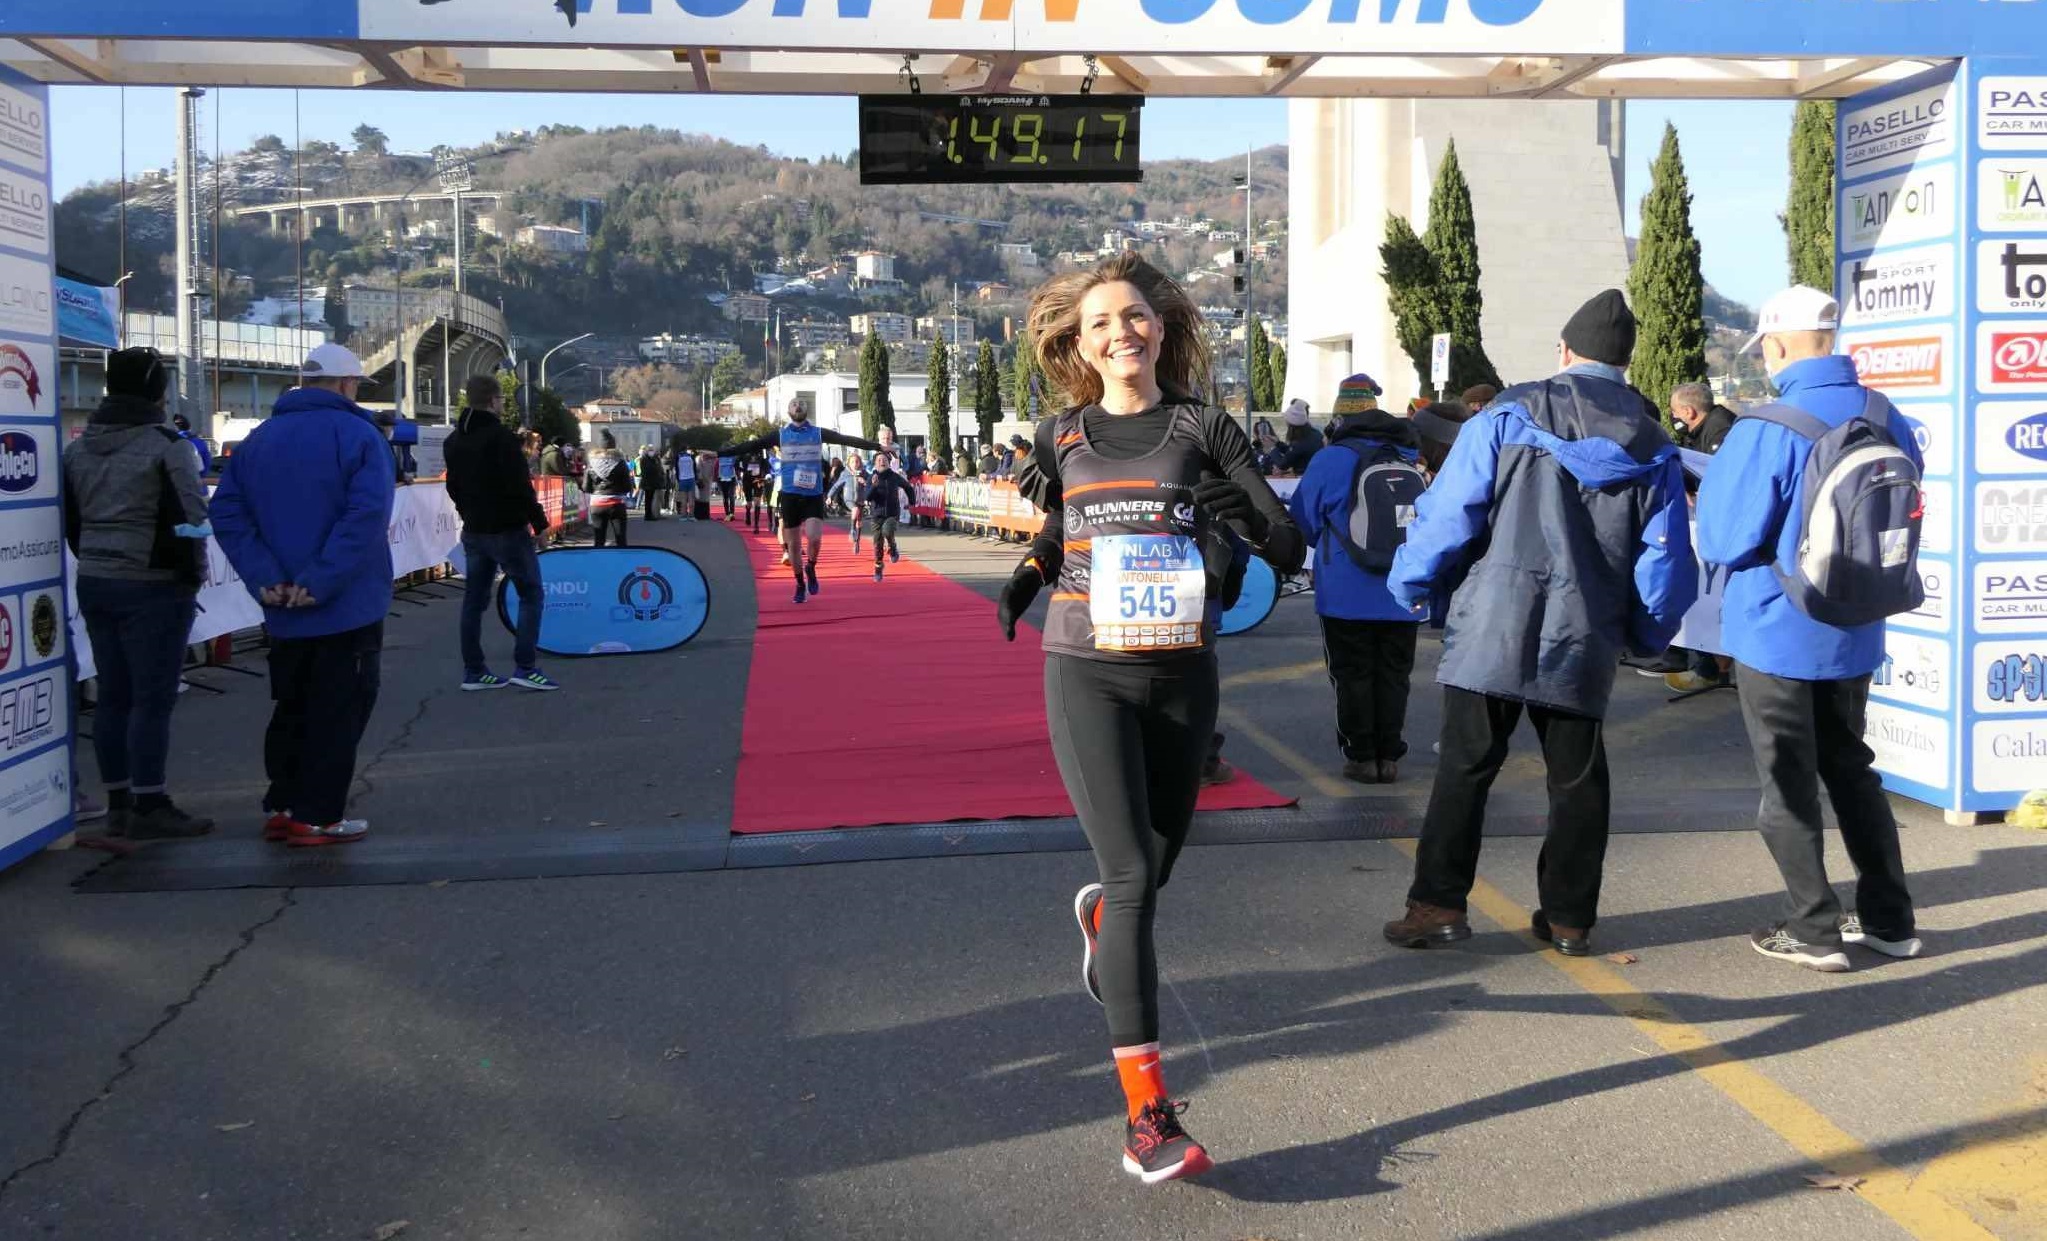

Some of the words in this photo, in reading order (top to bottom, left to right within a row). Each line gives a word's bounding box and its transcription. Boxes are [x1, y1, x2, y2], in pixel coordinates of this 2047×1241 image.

[1847, 99, 1944, 141] PASELLO
[1986, 120, 2021, 129] CAR
[2015, 423, 2047, 450] RE
[1084, 500, 1166, 517] RUNNERS
[1088, 515, 1140, 525] LEGNANO
[1119, 585, 1177, 618] 545
[1982, 604, 2018, 613] CAR
